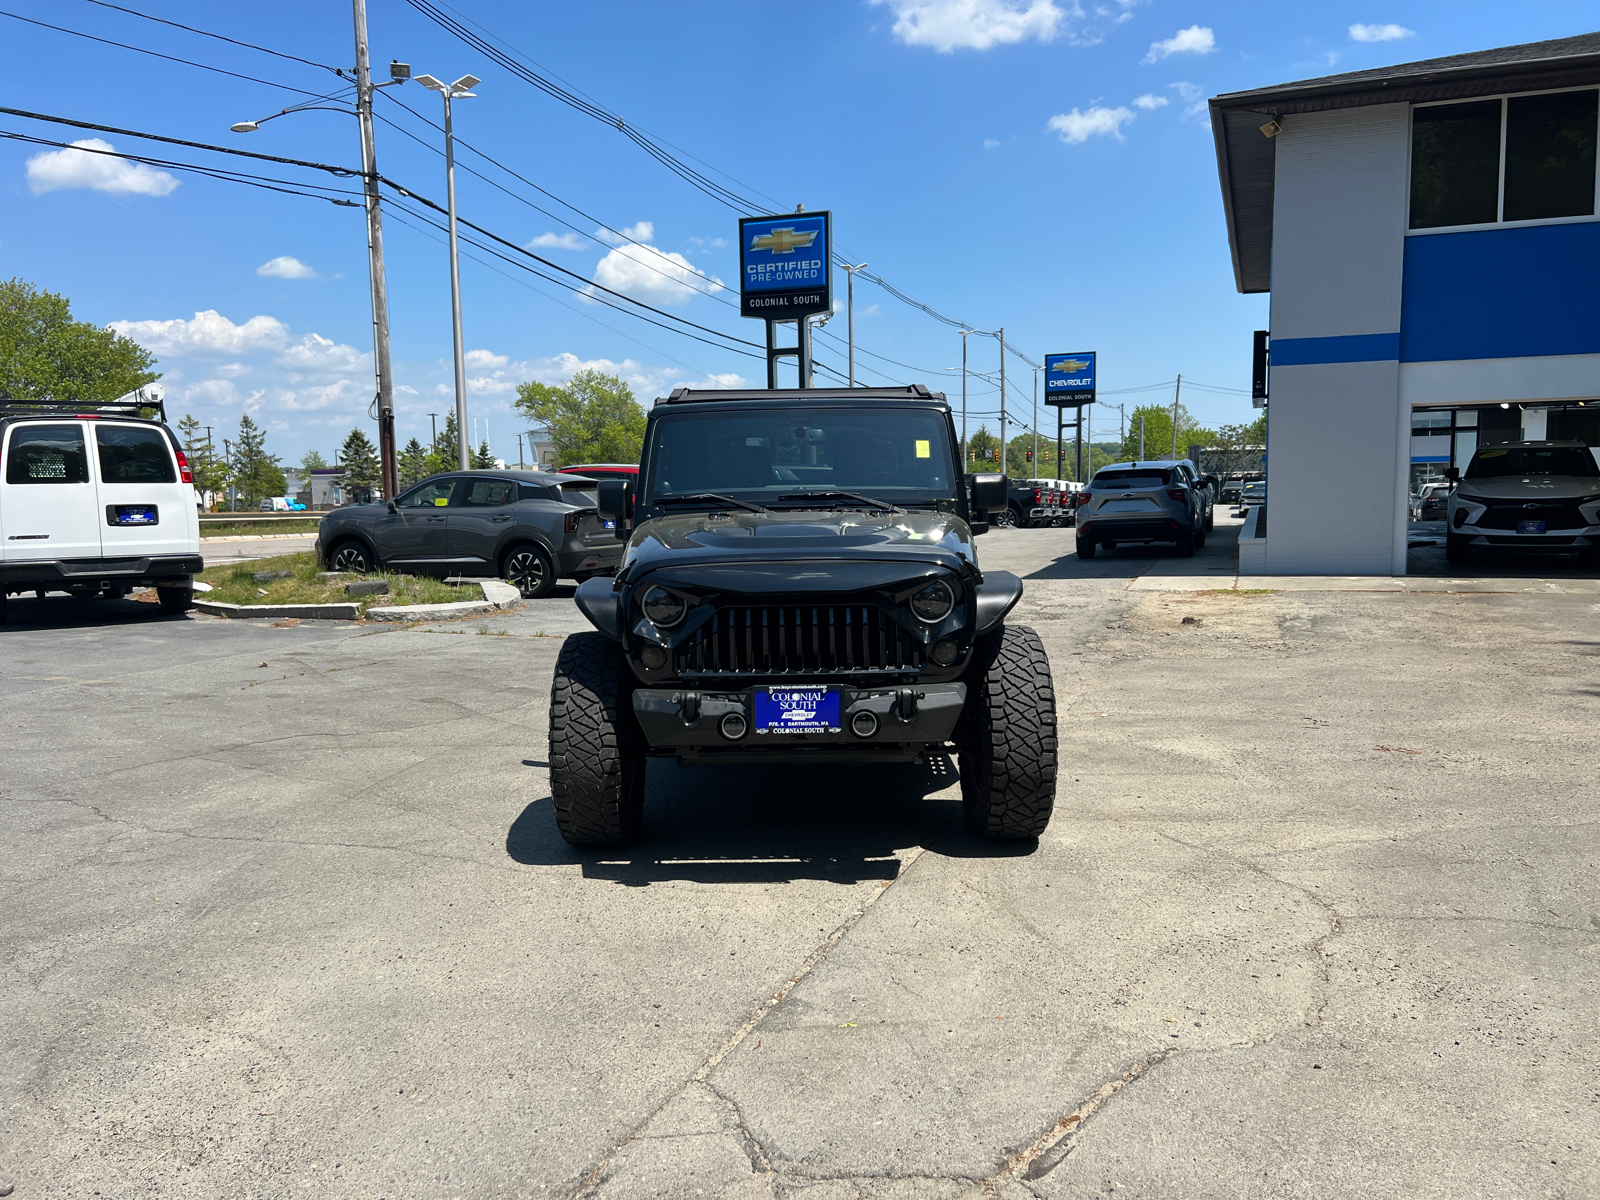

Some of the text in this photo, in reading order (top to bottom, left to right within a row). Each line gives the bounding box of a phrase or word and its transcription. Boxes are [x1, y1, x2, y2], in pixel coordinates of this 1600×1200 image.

[747, 260, 821, 274] CERTIFIED
[751, 270, 818, 282] PRE-OWNED
[749, 295, 820, 308] COLONIAL SOUTH
[1049, 378, 1092, 387] CHEVROLET
[771, 692, 825, 701] COLONIAL
[780, 701, 817, 710] SOUTH
